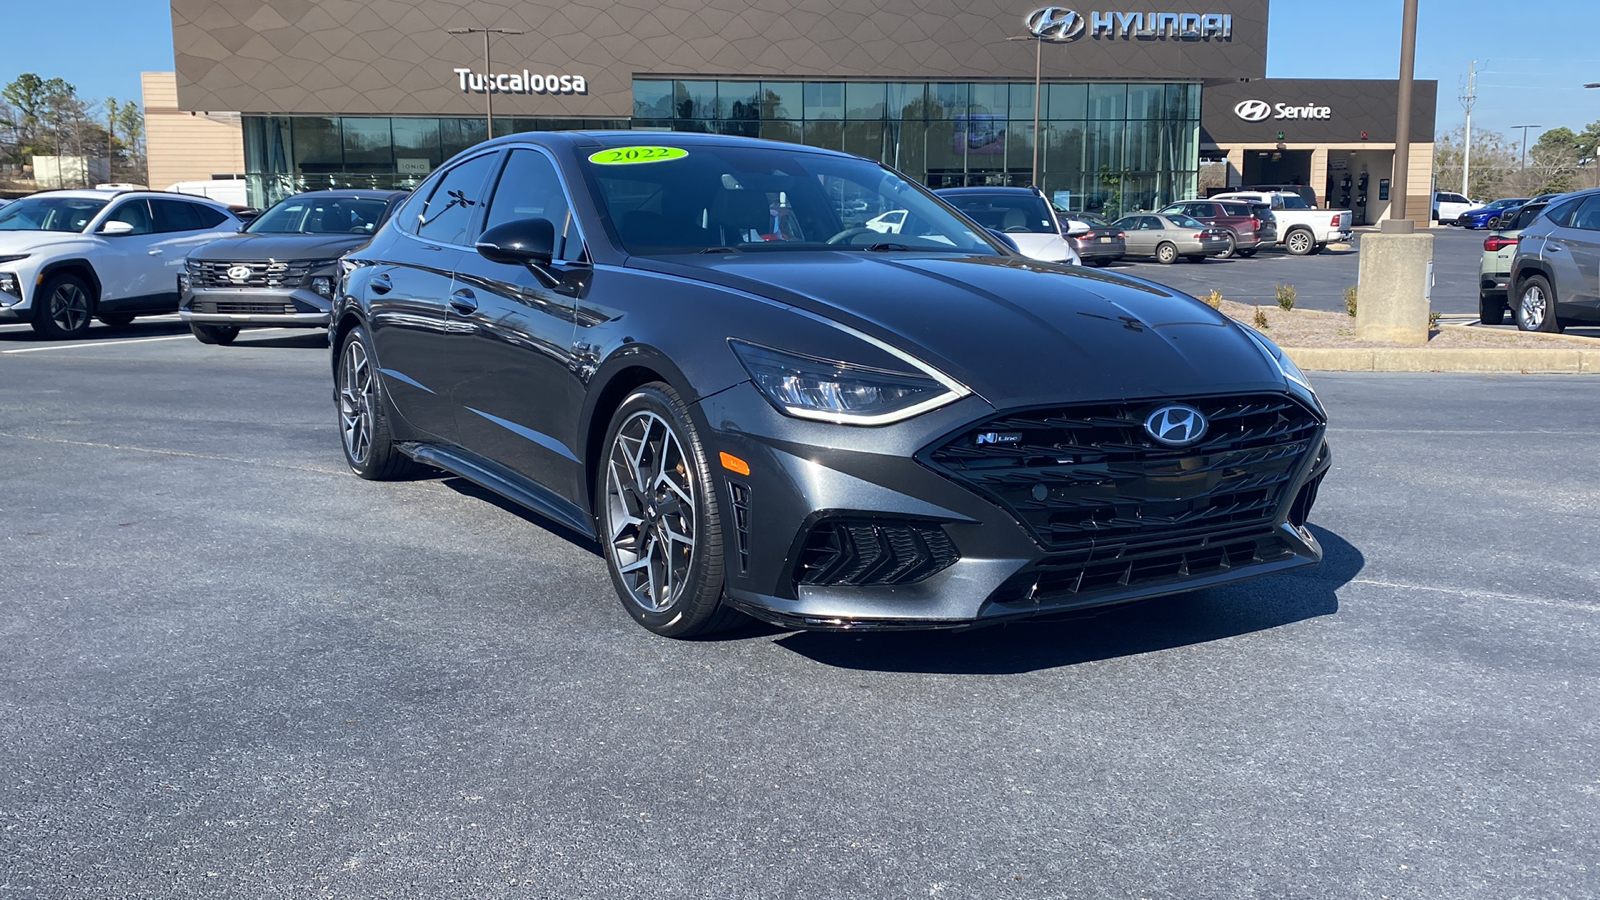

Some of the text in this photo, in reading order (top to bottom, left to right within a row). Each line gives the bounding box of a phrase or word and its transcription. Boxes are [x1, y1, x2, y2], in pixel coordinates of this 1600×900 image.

[1091, 11, 1232, 41] HYUNDAI
[453, 68, 588, 95] Tuscaloosa
[1274, 102, 1331, 120] Service
[609, 148, 669, 161] 2022
